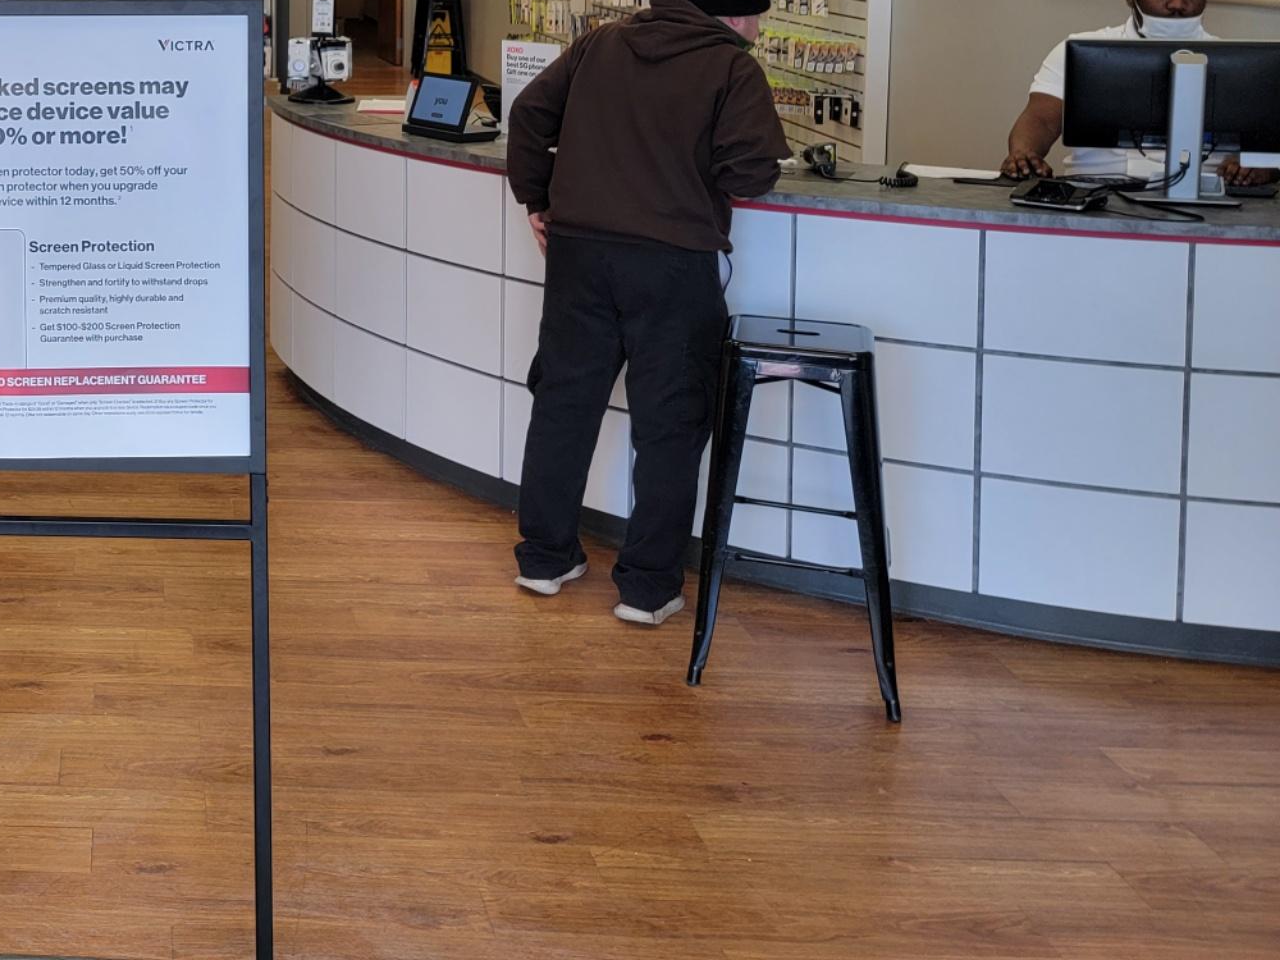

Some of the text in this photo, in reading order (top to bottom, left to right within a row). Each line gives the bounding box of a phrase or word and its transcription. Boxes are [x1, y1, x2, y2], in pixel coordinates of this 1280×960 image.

[158, 39, 215, 52] VICTRA
[43, 79, 136, 96] screens
[139, 80, 189, 99] may
[26, 101, 103, 120] device
[107, 100, 170, 120] value
[31, 130, 55, 145] or
[59, 125, 127, 145] more!
[12, 166, 63, 178] protector
[65, 166, 98, 177] today,
[100, 166, 117, 177] get
[119, 165, 145, 176] 50%
[146, 164, 162, 176] off
[163, 167, 188, 177] your
[6, 181, 57, 193] protector
[60, 181, 89, 191] when
[91, 183, 111, 192] you
[113, 180, 158, 192] upgrade
[25, 195, 58, 206] within
[60, 196, 72, 205] 12
[73, 195, 117, 206] months.
[29, 240, 155, 253] Screen Protection
[40, 261, 81, 271] Tempered
[83, 261, 106, 270] Glass
[117, 260, 143, 271] Liquid
[144, 261, 175, 270] Screen
[176, 260, 221, 269] Protection
[39, 277, 208, 288] Strengthen and fortify to withstand drops
[39, 293, 184, 305] Premium quality, highly durable and
[40, 305, 108, 314] scratch resistant
[40, 321, 181, 331] Get $100-$200 Screen Protection
[40, 333, 143, 343] Guarantee with purchase
[7, 376, 52, 387] SCREEN
[53, 375, 136, 386] REPLACEMENT
[137, 374, 207, 385] GUARANTEE
